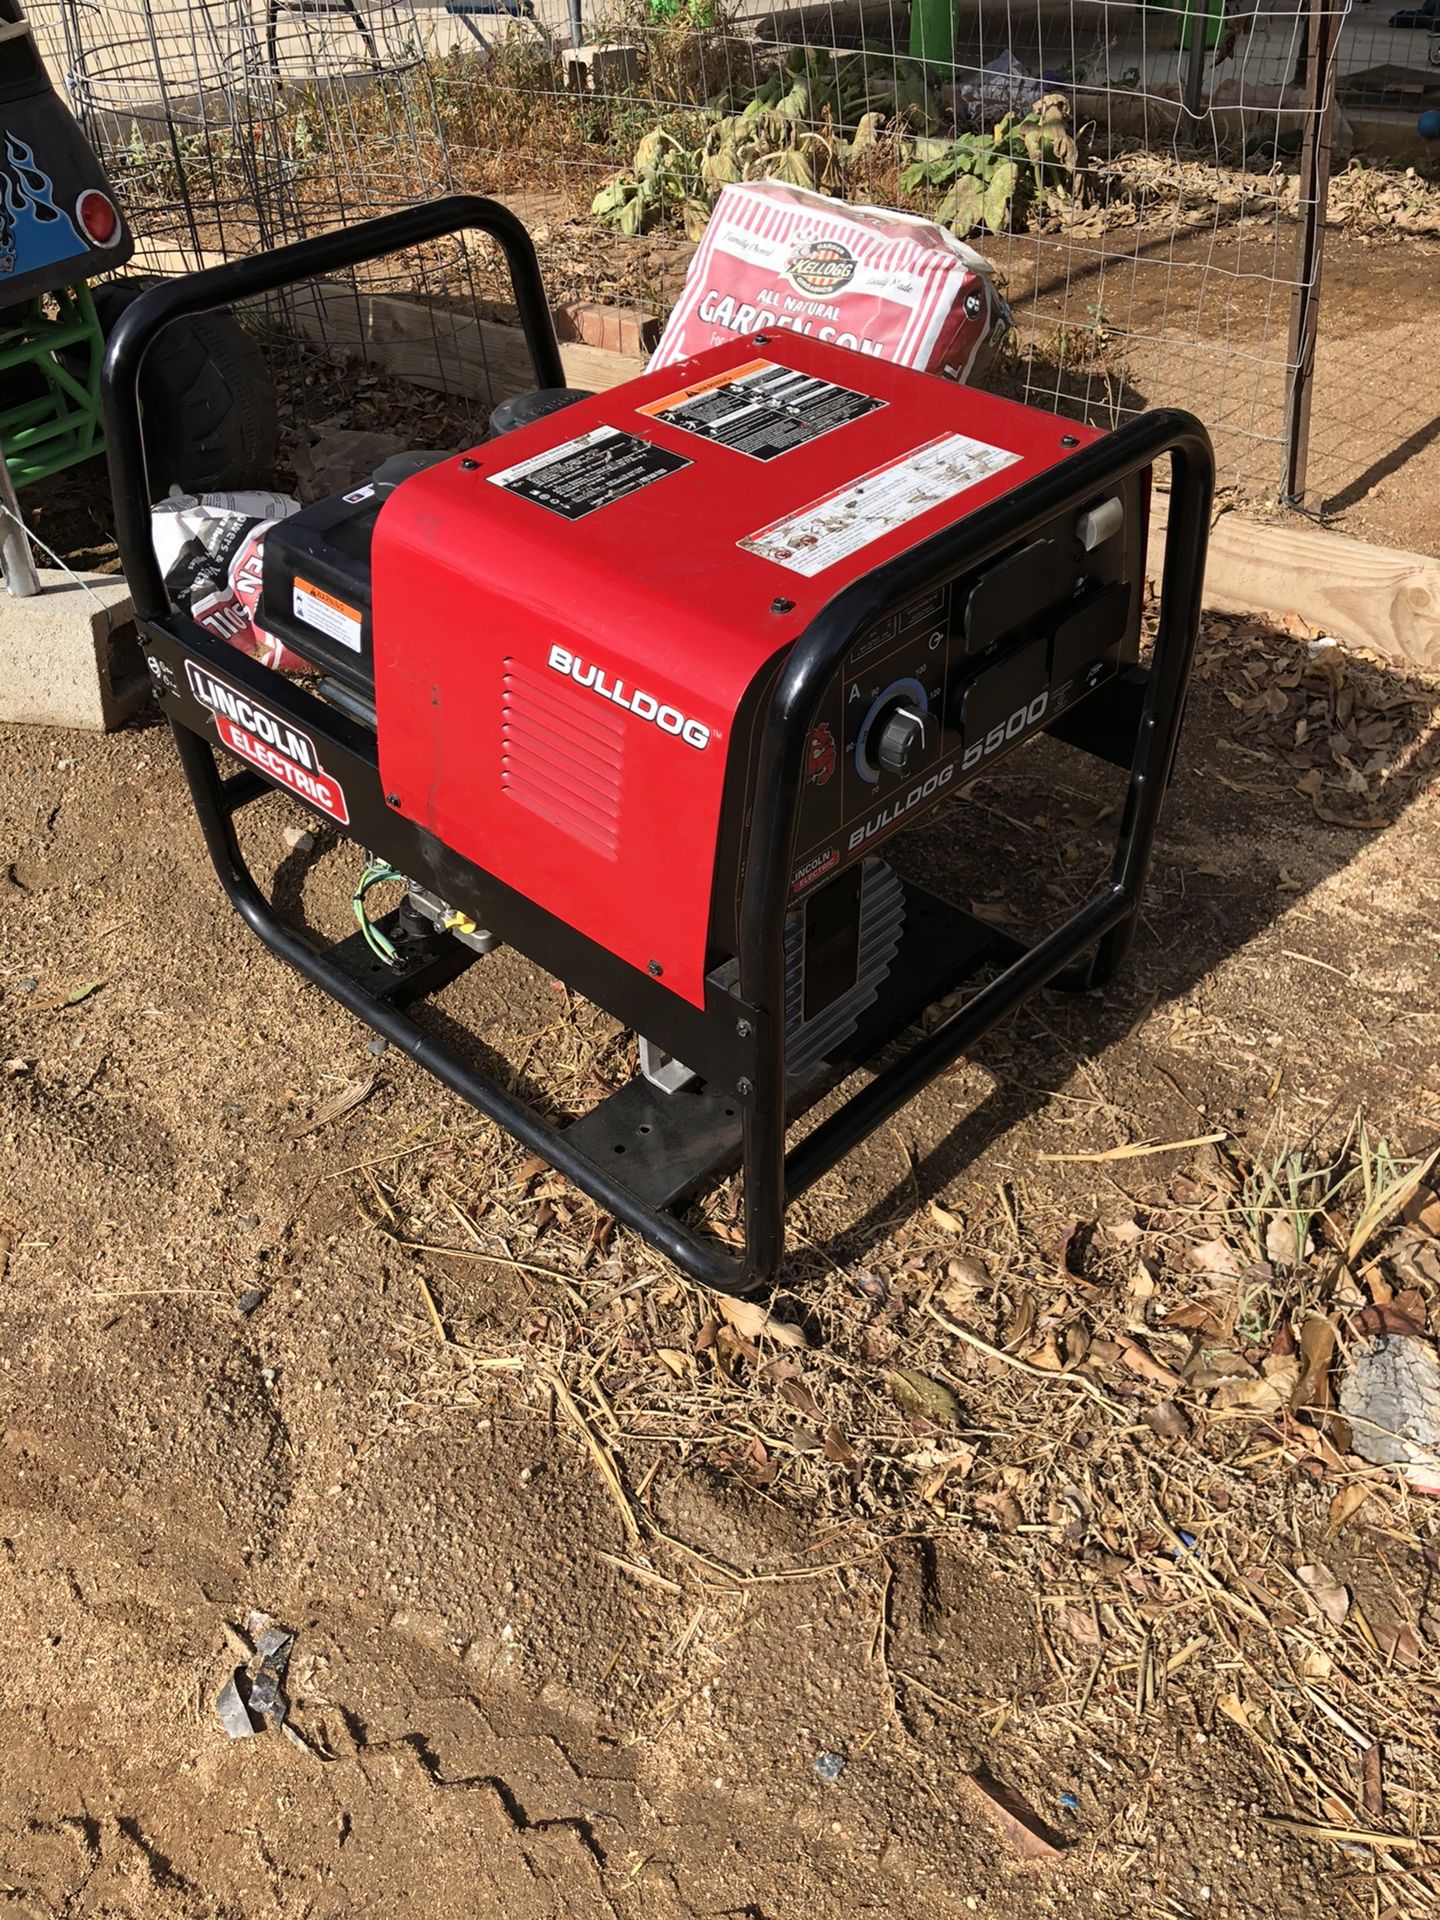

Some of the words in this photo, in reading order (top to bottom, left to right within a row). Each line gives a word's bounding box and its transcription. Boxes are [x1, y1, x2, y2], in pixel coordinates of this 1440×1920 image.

[792, 260, 853, 277] KELLOGG
[756, 289, 780, 307] ALL
[780, 296, 841, 322] NATURAL
[193, 670, 313, 770] LINCOLN
[547, 643, 711, 751] BULLDOG
[849, 683, 861, 704] A
[229, 724, 334, 808] ELECTRIC
[848, 763, 954, 850] BULLDOG
[962, 691, 1049, 771] 5500
[791, 850, 831, 884] INCOLN
